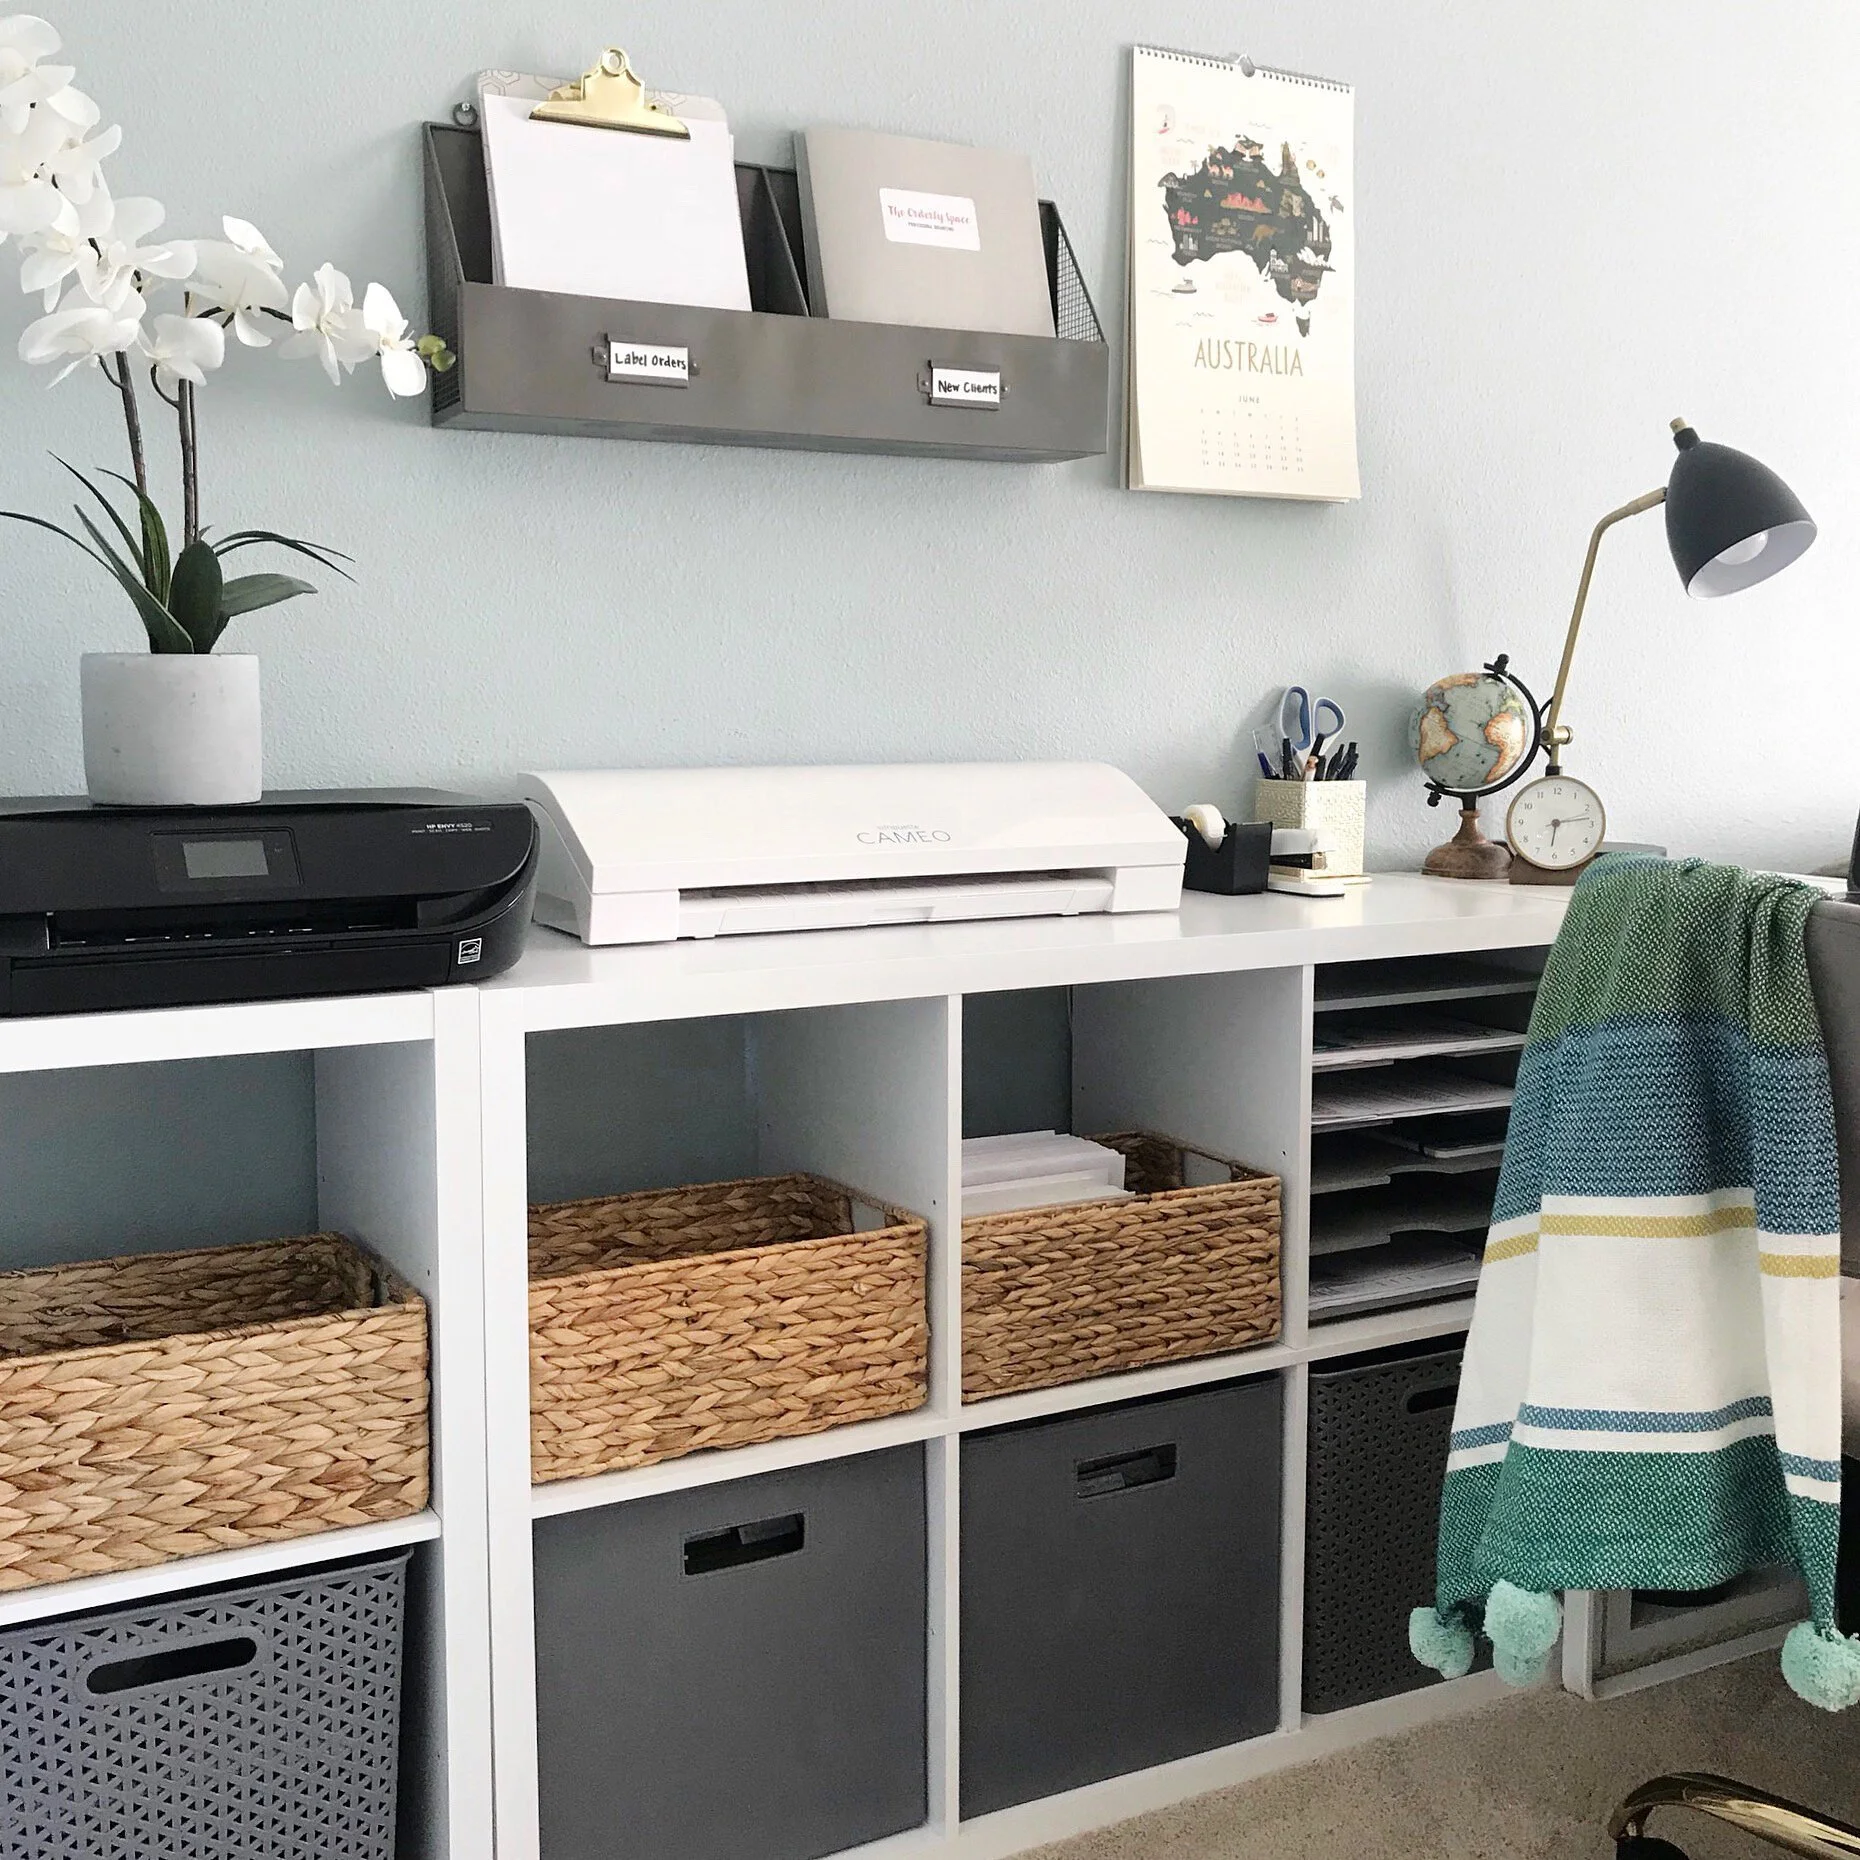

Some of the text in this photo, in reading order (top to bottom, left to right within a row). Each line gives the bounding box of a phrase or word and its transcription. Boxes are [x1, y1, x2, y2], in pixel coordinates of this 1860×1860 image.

[888, 205, 970, 225] The Orderly Space
[615, 351, 687, 370] Label Orders
[1194, 338, 1304, 377] AUSTRALIA
[938, 380, 998, 396] New Clients
[1238, 395, 1260, 404] JUNE
[1537, 791, 1544, 799] 11
[1553, 787, 1562, 795] 12
[1524, 802, 1533, 810] 10
[1584, 804, 1590, 812] 2
[1518, 818, 1524, 826] 9
[857, 830, 951, 844] CAMEO
[1523, 835, 1529, 843] 8
[1551, 852, 1558, 860] 6
[1570, 848, 1576, 856] 5
